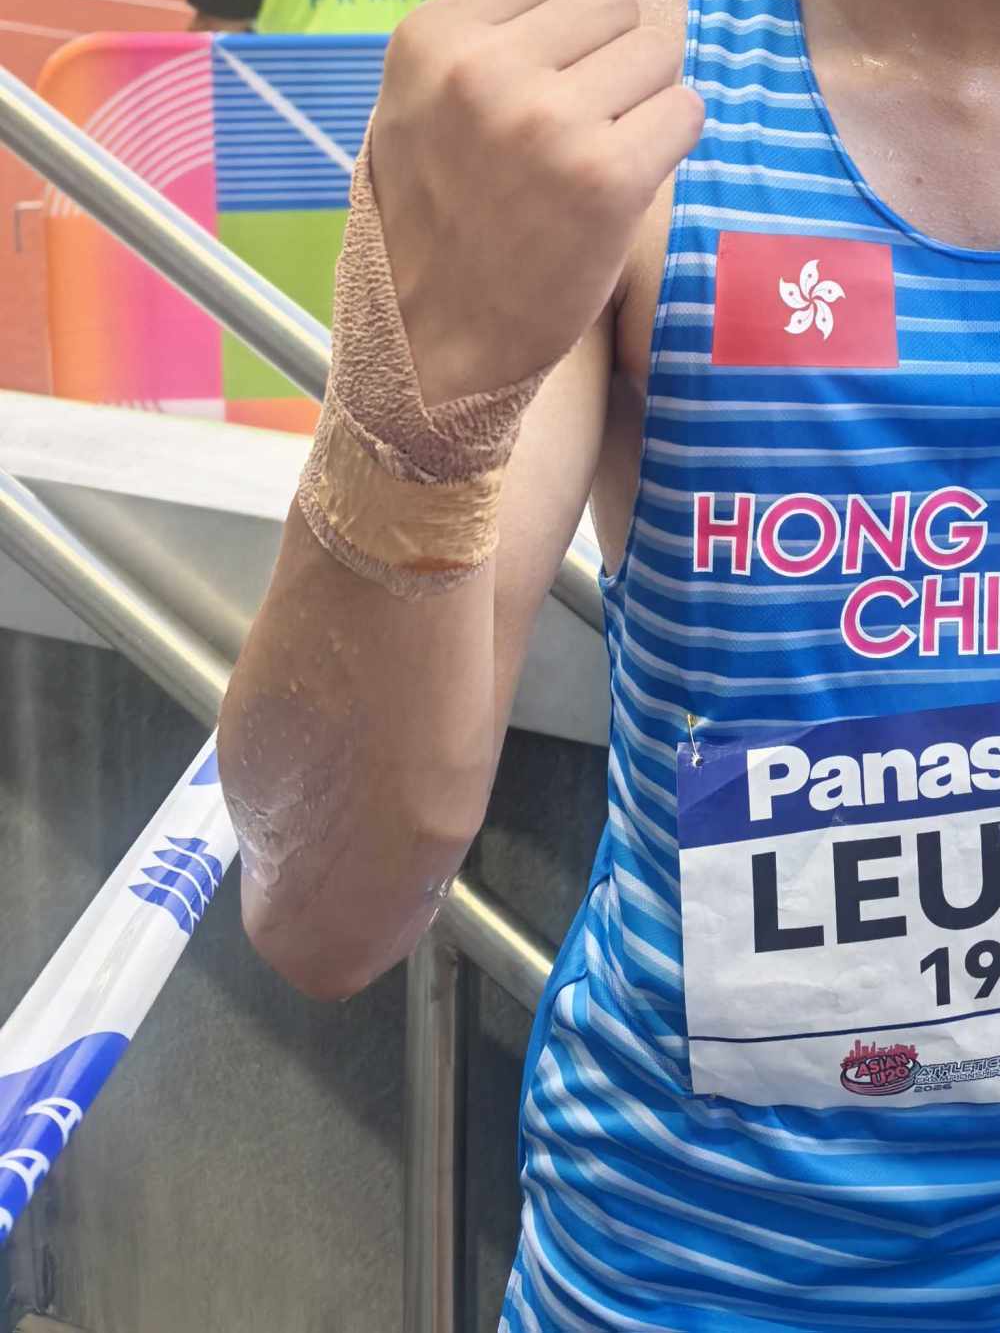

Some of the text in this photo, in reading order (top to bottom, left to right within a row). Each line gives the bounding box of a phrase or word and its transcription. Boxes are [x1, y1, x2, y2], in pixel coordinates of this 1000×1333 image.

[693, 486, 989, 577] HONG
[856, 1054, 910, 1078] ASIAN
[870, 1067, 910, 1086] U20
